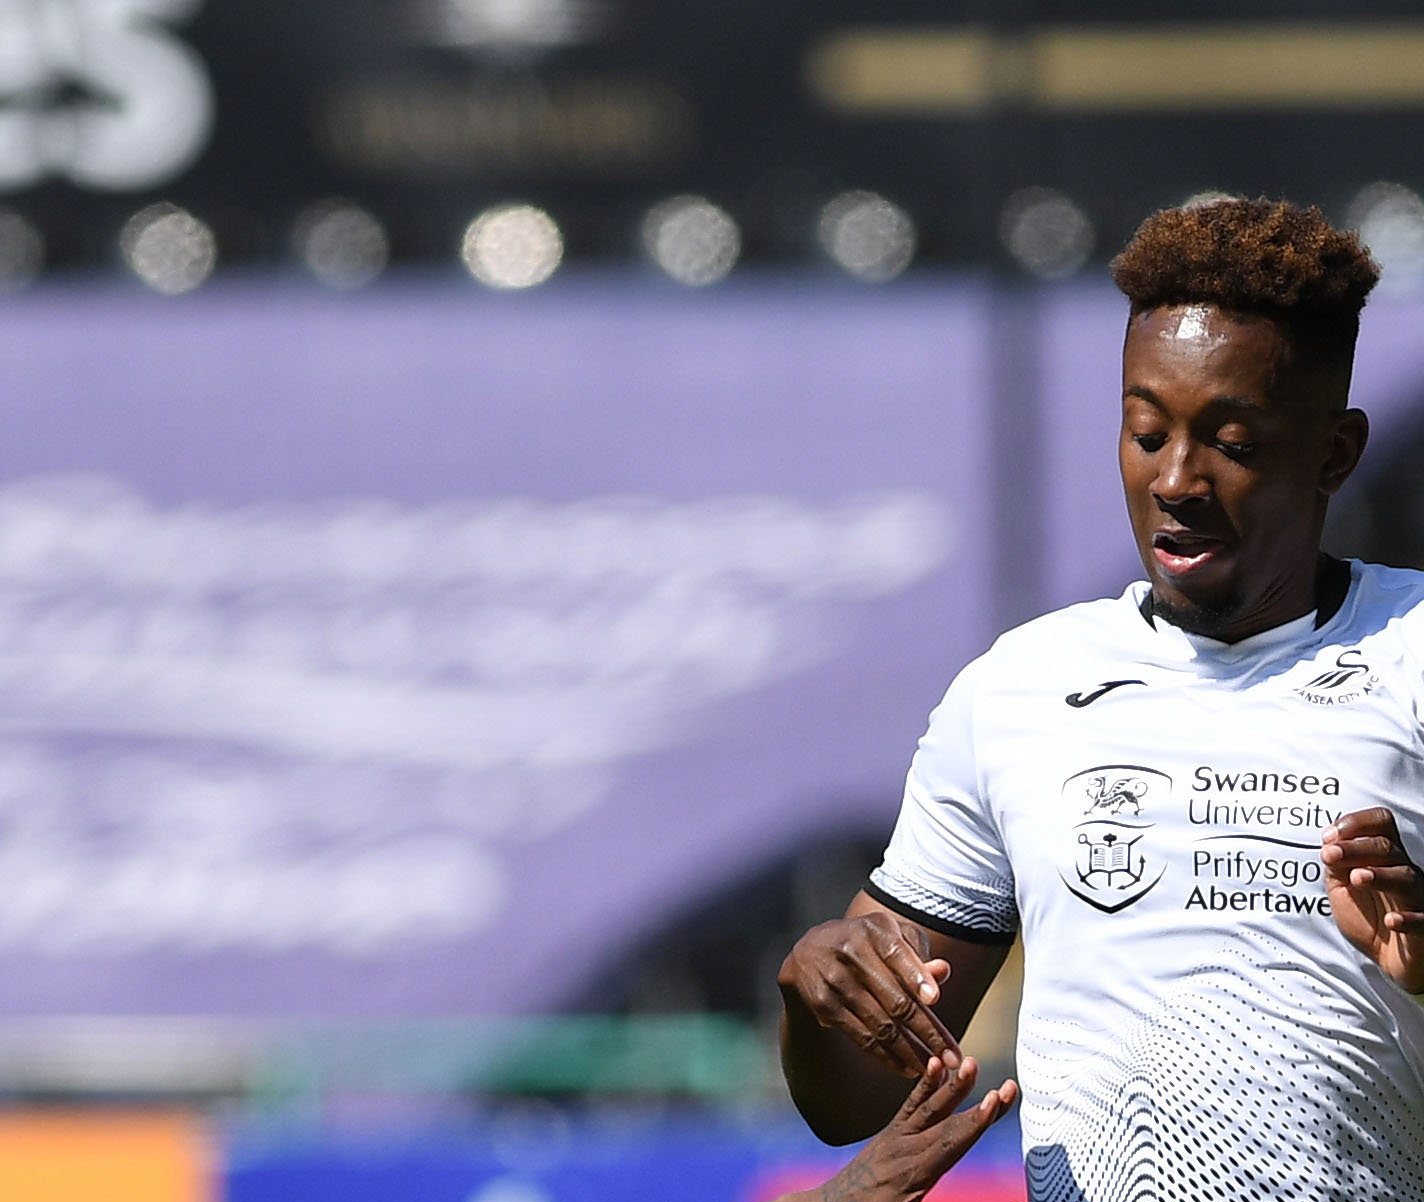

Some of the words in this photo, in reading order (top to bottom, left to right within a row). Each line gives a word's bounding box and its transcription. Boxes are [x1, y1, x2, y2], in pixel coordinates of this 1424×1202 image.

[1191, 765, 1340, 797] Swansea
[1188, 798, 1342, 829] University
[1193, 850, 1322, 887] Prifysgo
[1184, 884, 1332, 917] Abertawe
